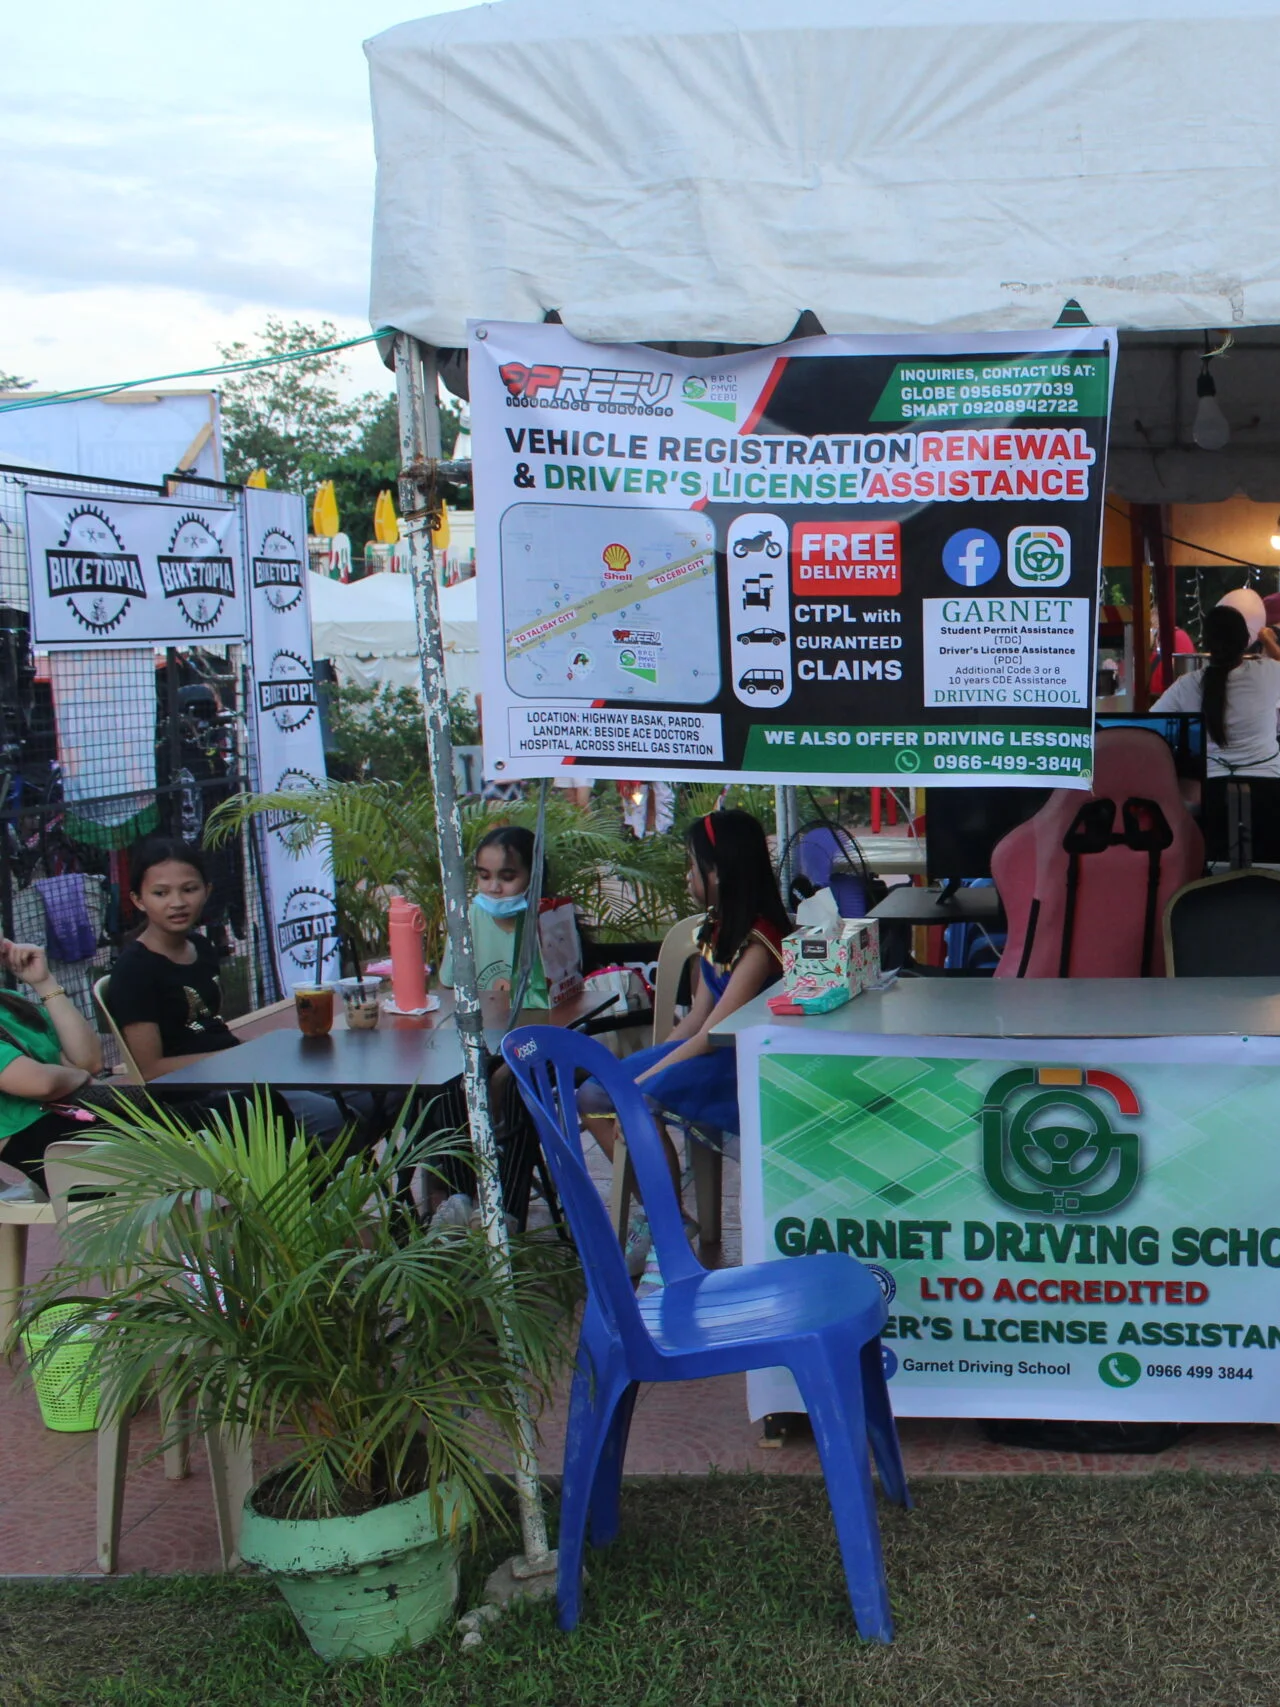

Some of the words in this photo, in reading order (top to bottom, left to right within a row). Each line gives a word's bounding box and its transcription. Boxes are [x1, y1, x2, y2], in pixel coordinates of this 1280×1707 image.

[711, 375, 738, 384] BPCI
[901, 368, 978, 382] INQUIRIES,
[983, 365, 1048, 380] CONTACT
[1052, 365, 1070, 377] US
[1074, 364, 1096, 377] AT:
[711, 384, 738, 392] PMVIC
[711, 392, 738, 401] CEBU
[901, 386, 956, 400] GLOBE
[960, 383, 1074, 399] 09565077039
[506, 396, 590, 412] INSURANCE
[598, 403, 674, 417] SERVICES
[902, 402, 960, 417] SMART
[962, 400, 1079, 415] 09208942722
[505, 427, 648, 460] VEHICLE
[659, 437, 911, 465] REGISTRATION
[922, 434, 1092, 462] RENEWAL
[513, 462, 536, 489] &
[545, 464, 701, 496] DRIVER'S
[711, 472, 858, 498] LICENSE
[866, 470, 1085, 498] ASSISTANCE
[801, 533, 895, 561] FREE
[48, 557, 144, 592] BIKETOPIA
[160, 562, 233, 592] BIKETOPIA
[604, 572, 632, 581] Shell
[655, 576, 665, 584] TO
[667, 568, 686, 580] CEBU
[687, 559, 705, 571] CITY
[800, 565, 897, 579] DELIVERY!
[794, 604, 857, 623] CTPL
[862, 608, 901, 623] with
[942, 600, 1073, 623] GARNET
[514, 634, 526, 643] TO
[526, 620, 557, 638] TALISAY
[558, 611, 575, 623] CITY
[941, 626, 981, 635] Student
[983, 626, 1018, 635] Permit
[1020, 626, 1074, 635] Assistance
[796, 636, 902, 649] GURANTEED
[939, 647, 978, 655] Driver's
[981, 647, 1019, 655] License
[1022, 647, 1075, 655] Assistance
[797, 660, 902, 681] CLAIMS
[955, 666, 1005, 675] Additional
[1007, 666, 1031, 674] Code
[1034, 666, 1040, 674] 3
[1054, 666, 1060, 674] 8
[964, 678, 990, 686] years
[992, 677, 1012, 685] CDE
[1015, 677, 1067, 685] Assistance
[934, 689, 1007, 703] DRIVING
[1013, 689, 1081, 703] SCHOOL
[527, 712, 580, 723] LOCATION:
[582, 713, 628, 724] HIGHWAY
[630, 714, 666, 727] BASAK,
[668, 716, 704, 728] PARDO.
[533, 725, 592, 737] LANDMARK:
[594, 727, 630, 738] BESIDE
[633, 728, 651, 739] ACE
[654, 729, 700, 741] DOCTORS
[764, 730, 795, 745] WE
[800, 730, 851, 746] ALSO
[855, 731, 918, 746] OFFER
[923, 731, 1004, 746] DRIVING
[520, 739, 572, 751] HOSPITAL,
[575, 740, 615, 751] ACROSS
[617, 741, 648, 753] SHELL
[651, 742, 670, 753] GAS
[672, 743, 713, 755] STATION
[933, 755, 1081, 771] 0966-499-3844
[774, 1217, 952, 1261] GARNET
[964, 1220, 1159, 1266] DRIVING
[920, 1276, 984, 1301] LTO
[993, 1278, 1210, 1305] ACCREDITED
[963, 1318, 1108, 1345] LICENSE
[903, 1358, 954, 1373] Garnet
[958, 1360, 1013, 1377] Driving
[1018, 1361, 1071, 1375] School
[1147, 1364, 1182, 1378] 0966
[1187, 1365, 1213, 1379] 499
[1218, 1366, 1253, 1380] 3844
